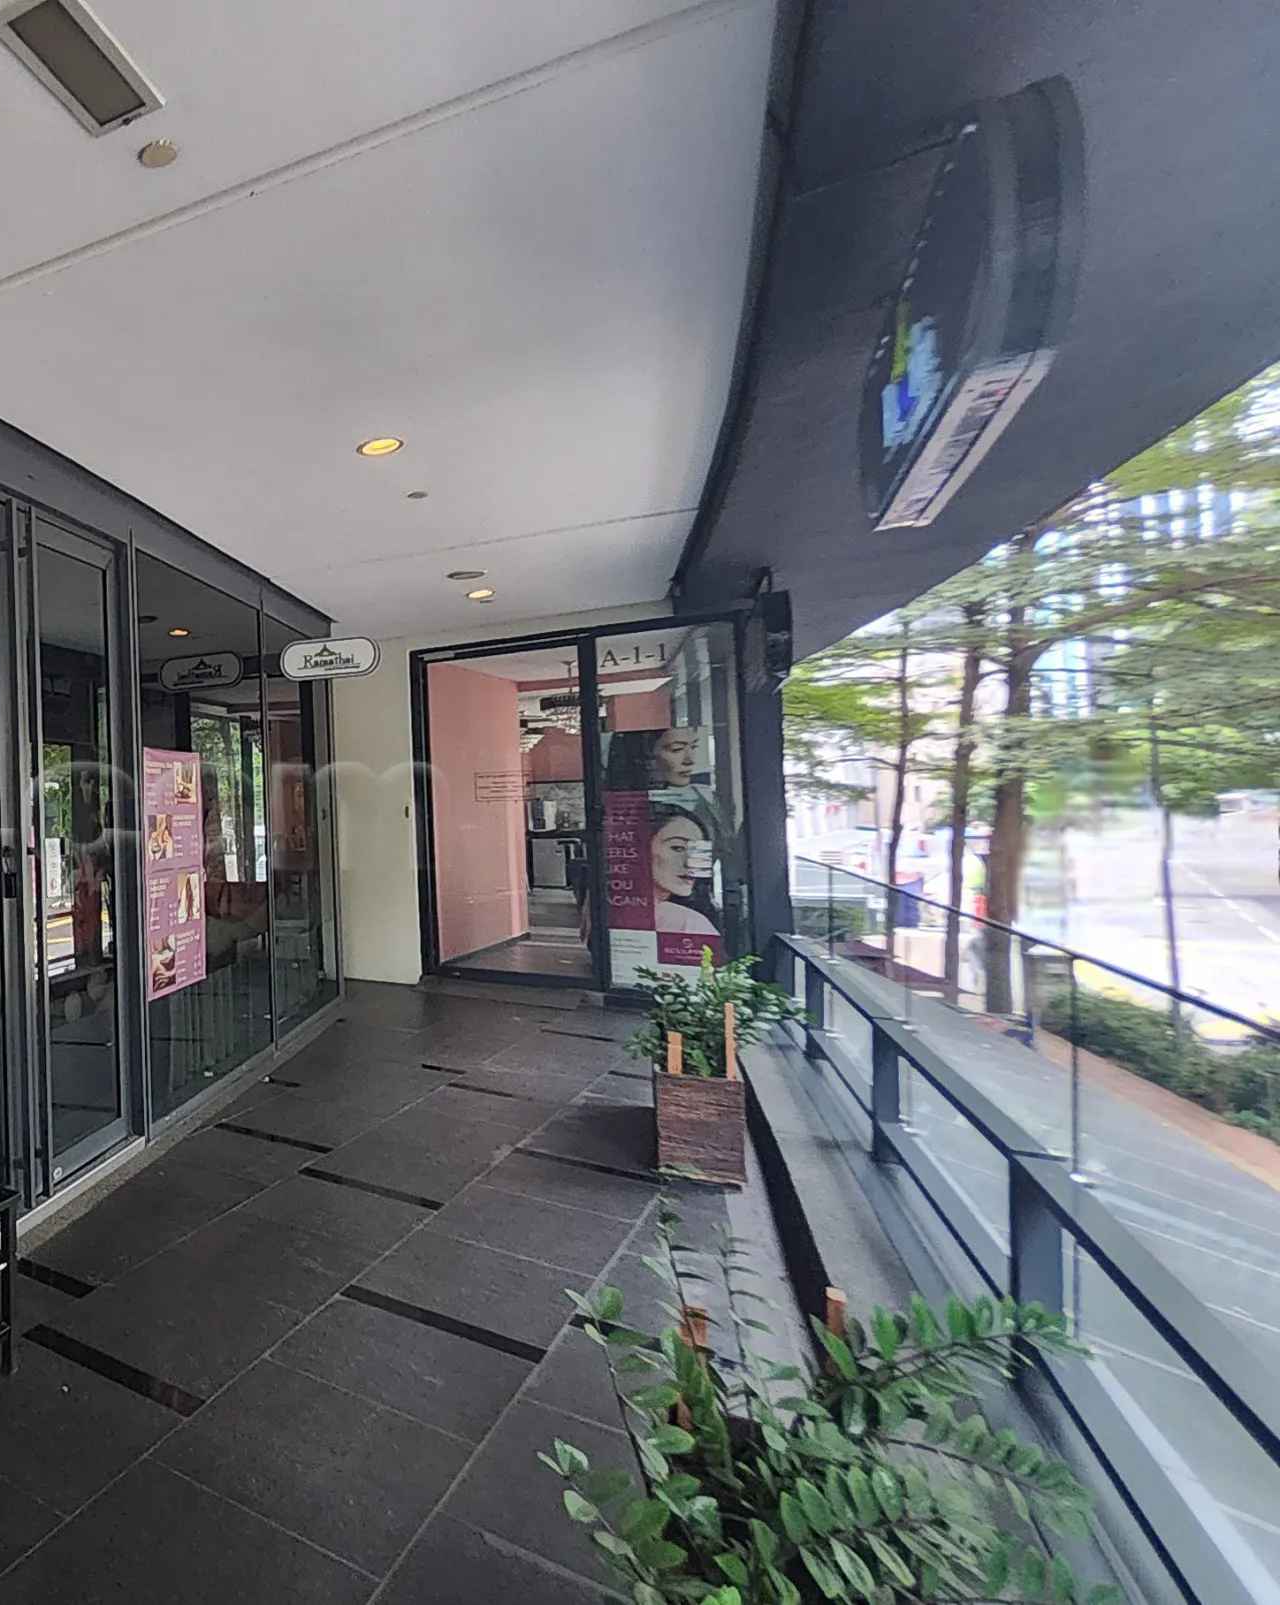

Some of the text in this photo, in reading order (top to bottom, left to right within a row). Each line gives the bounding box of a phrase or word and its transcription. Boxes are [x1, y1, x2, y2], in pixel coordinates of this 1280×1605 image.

[600, 643, 666, 668] A-1-1
[607, 831, 636, 842] HAT
[606, 847, 638, 859] EELS
